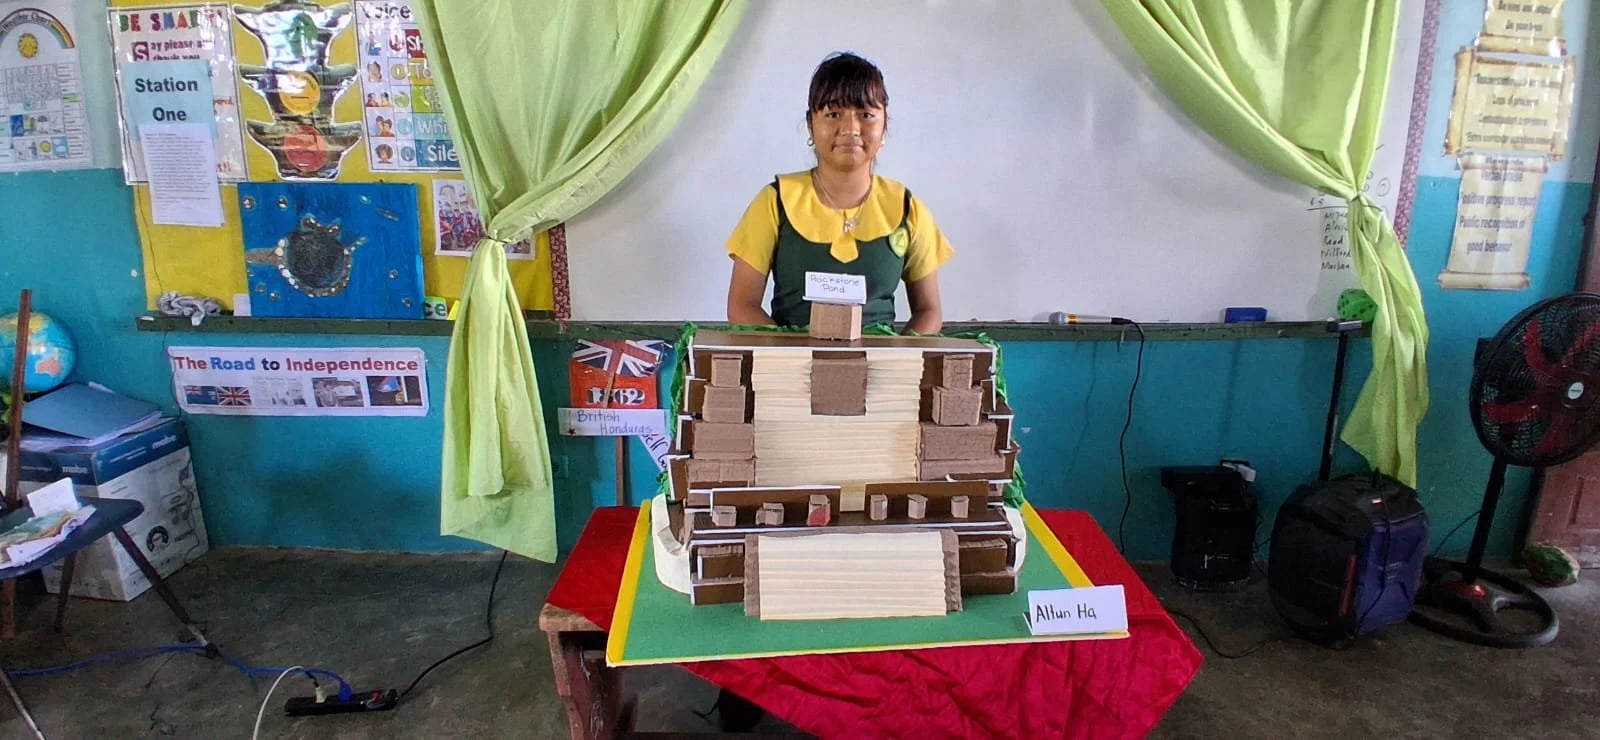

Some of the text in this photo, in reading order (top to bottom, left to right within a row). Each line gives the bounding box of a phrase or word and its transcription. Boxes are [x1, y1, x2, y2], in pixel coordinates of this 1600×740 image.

[119, 13, 141, 32] BE
[164, 40, 193, 51] please
[134, 77, 199, 93] Station
[152, 107, 187, 122] One
[822, 284, 845, 294] Pond
[173, 356, 419, 374] The Road to Independence
[577, 409, 621, 423] British
[600, 421, 654, 435] Honduras
[1036, 603, 1097, 623] Altun Ha
